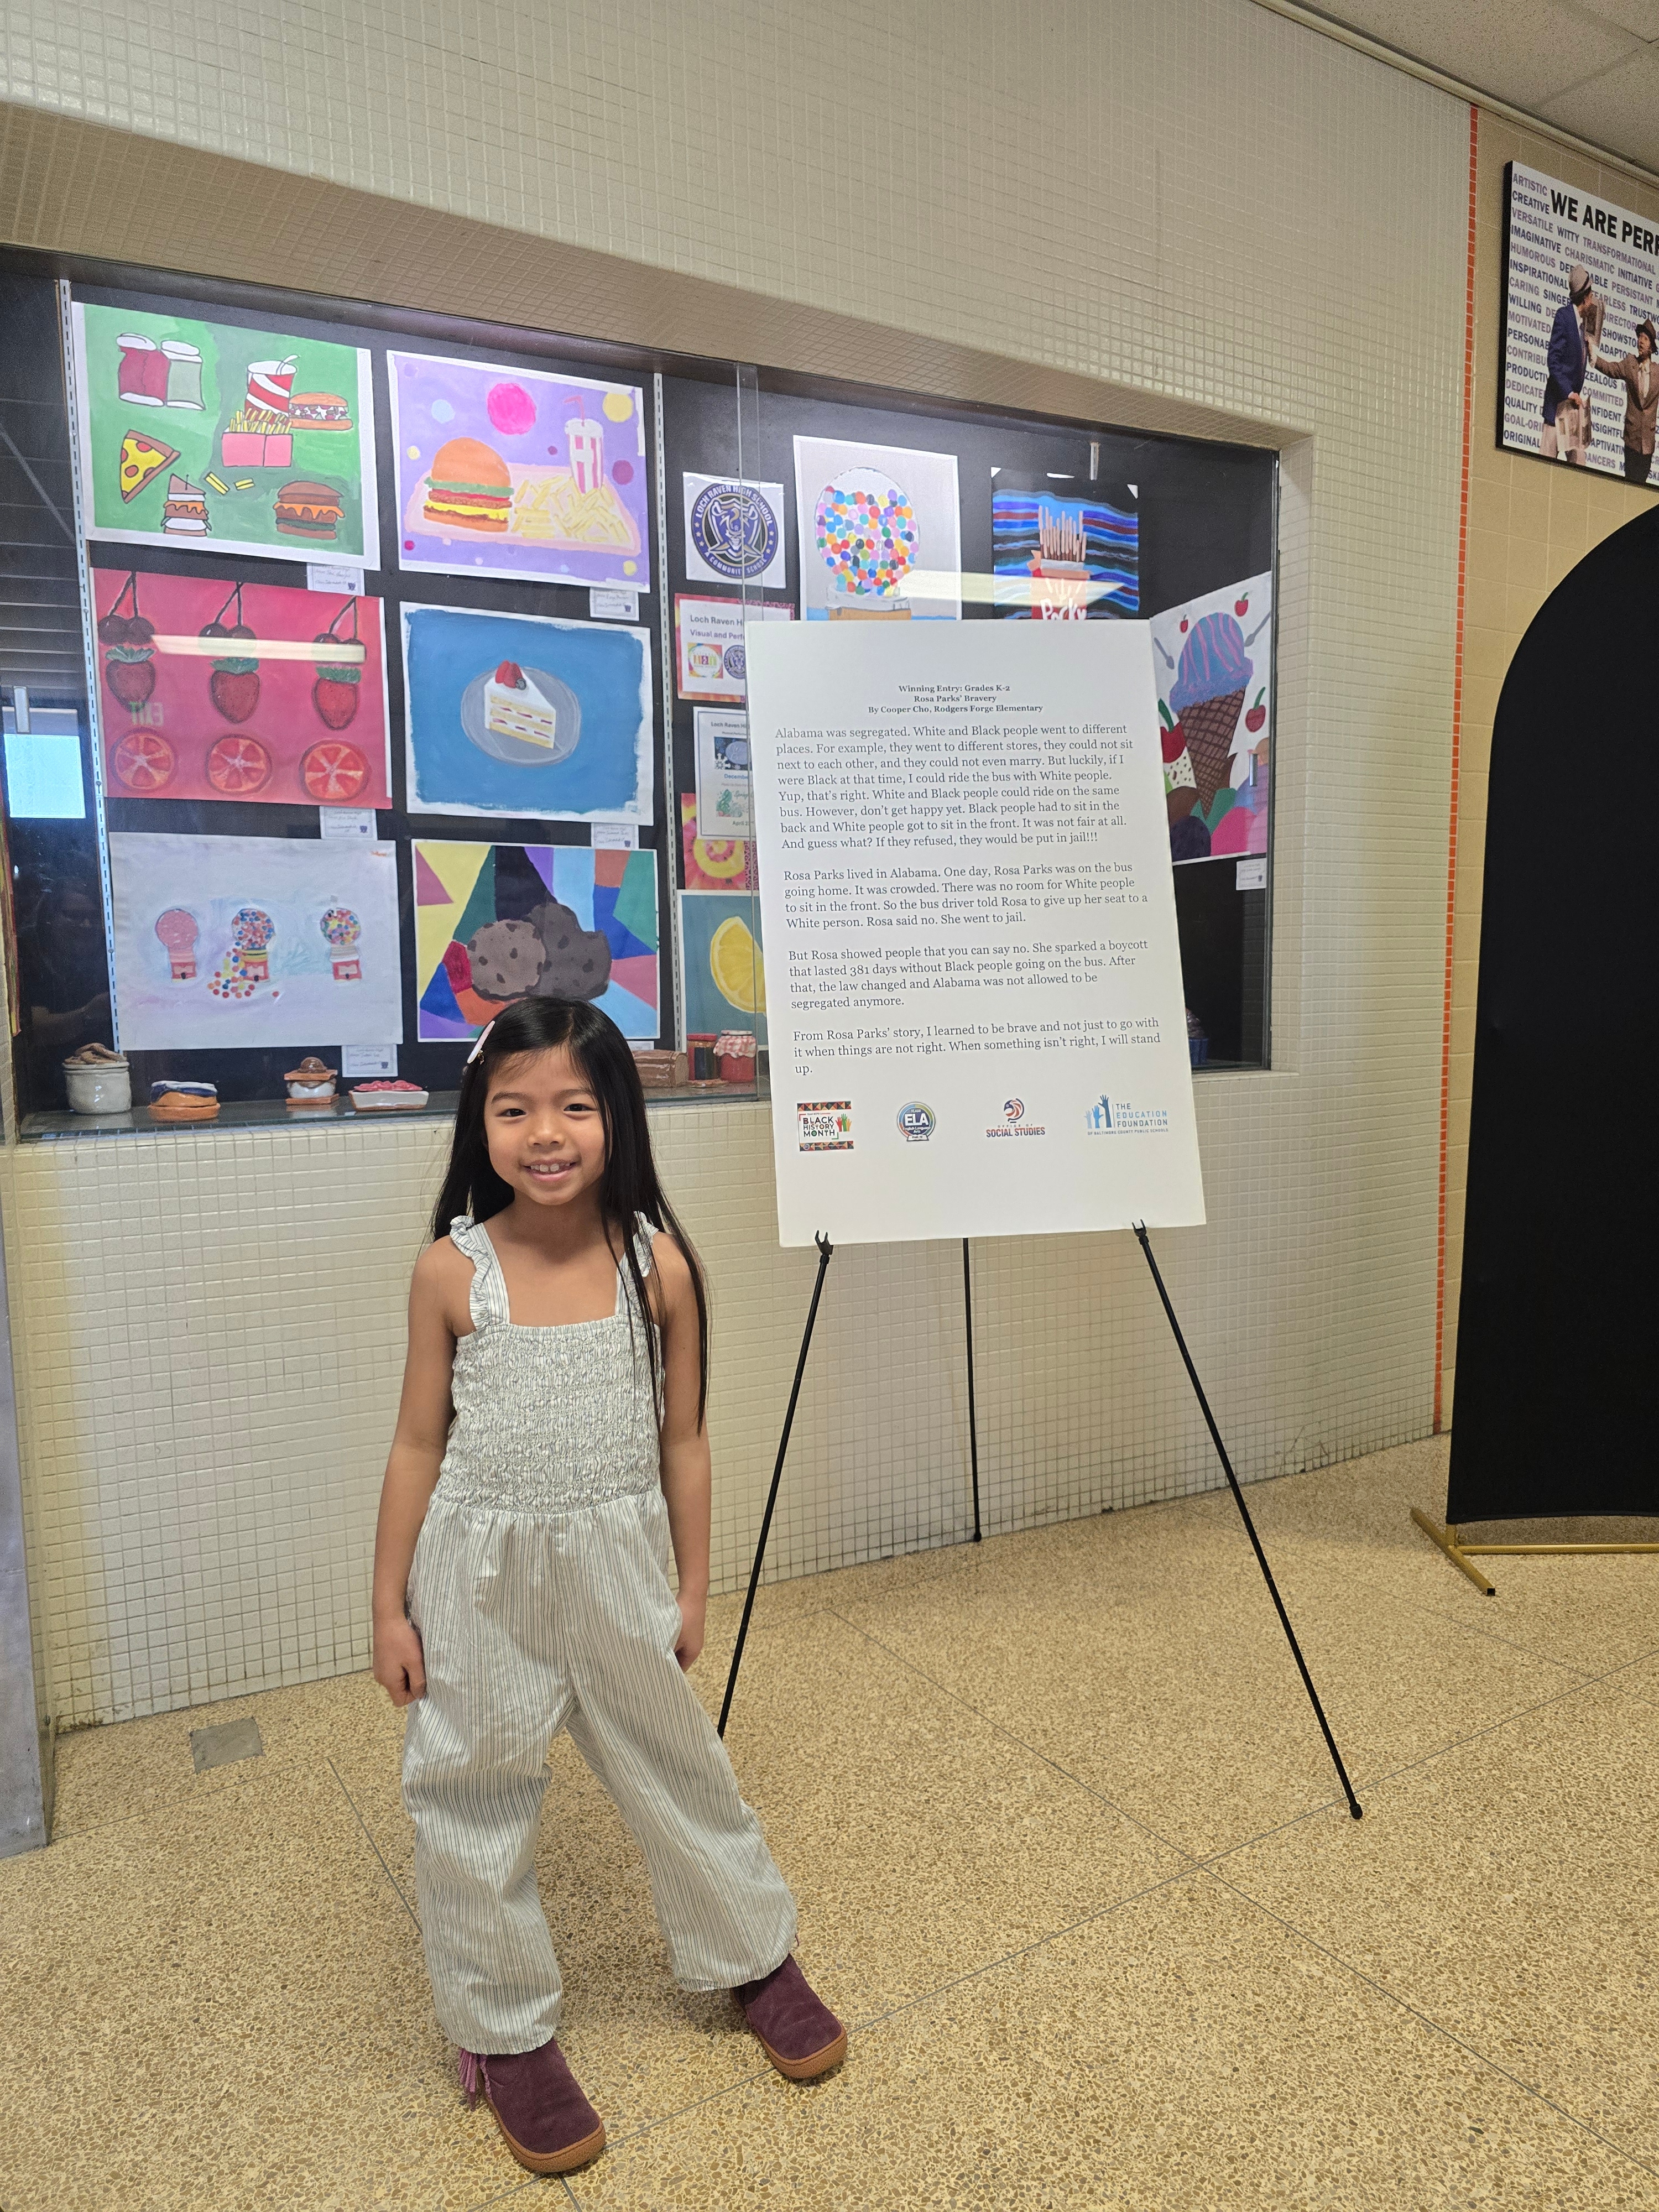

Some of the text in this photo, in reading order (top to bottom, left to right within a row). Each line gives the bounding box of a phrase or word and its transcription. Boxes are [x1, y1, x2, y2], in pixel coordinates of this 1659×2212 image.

[1513, 173, 1547, 196] ARTISTIC
[1512, 191, 1550, 215] CREATIVE
[1551, 189, 1578, 222] WE
[1582, 205, 1618, 239] ARE
[1512, 207, 1656, 275] VERSATILE WITTY TRANSFORMATIONAL
[1511, 225, 1652, 290] IMAGINATIVE CHARISMATIC INITIATIVE
[1510, 242, 1653, 305] HUMOROUS PERSISTANT
[1510, 259, 1568, 290] INSPIRATIONAL
[1510, 276, 1540, 296] CARING
[1509, 293, 1541, 314] WILLING
[1508, 311, 1551, 333] MOTIVATED
[1585, 371, 1617, 389] ZEALOUS
[1505, 396, 1537, 414] QUALITY
[1582, 386, 1624, 408] COMMITTED
[1504, 430, 1540, 448] ORIGINAL
[696, 495, 710, 518] LOCH
[708, 486, 732, 499] RAVEN
[752, 494, 773, 527] SCHOOL
[690, 615, 734, 625] Loch Raven
[690, 629, 712, 638] Visual
[899, 685, 935, 693] Winning
[775, 728, 823, 738] Alabama
[850, 726, 910, 739] segregated.
[912, 726, 946, 736] White
[949, 726, 968, 735] and
[972, 725, 1000, 735] Black
[1003, 725, 1038, 737] people
[1070, 726, 1079, 734] to
[1083, 724, 1127, 734] different
[781, 832, 1098, 851] And guess what? If they refused, they would be put in jail!!!
[784, 871, 811, 880] Rosa
[814, 869, 844, 879] Parks
[847, 869, 873, 879] lived
[877, 869, 887, 878] in
[890, 868, 940, 878] Alabama.
[944, 867, 966, 877] One
[969, 866, 990, 878] day,
[994, 866, 1020, 875] Rosa
[1023, 864, 1052, 874] Parks
[1095, 863, 1111, 872] the
[1114, 862, 1132, 872] bus
[786, 918, 820, 928] White
[823, 920, 863, 930] person.
[867, 917, 893, 926] Rosa
[896, 915, 918, 925] said
[941, 914, 961, 924] She
[963, 914, 989, 923] went
[993, 914, 1003, 922] to
[1005, 912, 1026, 925] jail.
[789, 951, 808, 961] But
[811, 950, 838, 960] Rosa
[841, 948, 882, 959] showed
[885, 947, 921, 960] people
[924, 946, 946, 957] that
[948, 948, 968, 958] you
[993, 947, 1010, 956] say
[1033, 942, 1052, 952] She
[1055, 941, 1097, 954] sparked
[1109, 940, 1148, 952] boycott
[790, 982, 815, 994] that,
[819, 982, 836, 992] the
[839, 981, 858, 991] law
[862, 979, 906, 992] changed
[910, 978, 930, 988] and
[933, 977, 980, 988] Alabama
[1007, 977, 1024, 985] not
[1027, 973, 1068, 984] allowed
[1071, 974, 1082, 983] to
[1084, 972, 1097, 982] be
[791, 997, 904, 1010] segregated anymore.
[795, 1066, 812, 1076] up.
[803, 1116, 834, 1124] BLACK
[905, 1113, 928, 1126] ELA
[1117, 1110, 1167, 1119] EDUCATION
[1117, 1119, 1167, 1128] FOUNDATION
[986, 1127, 1045, 1138] SOCIAL STUDIES
